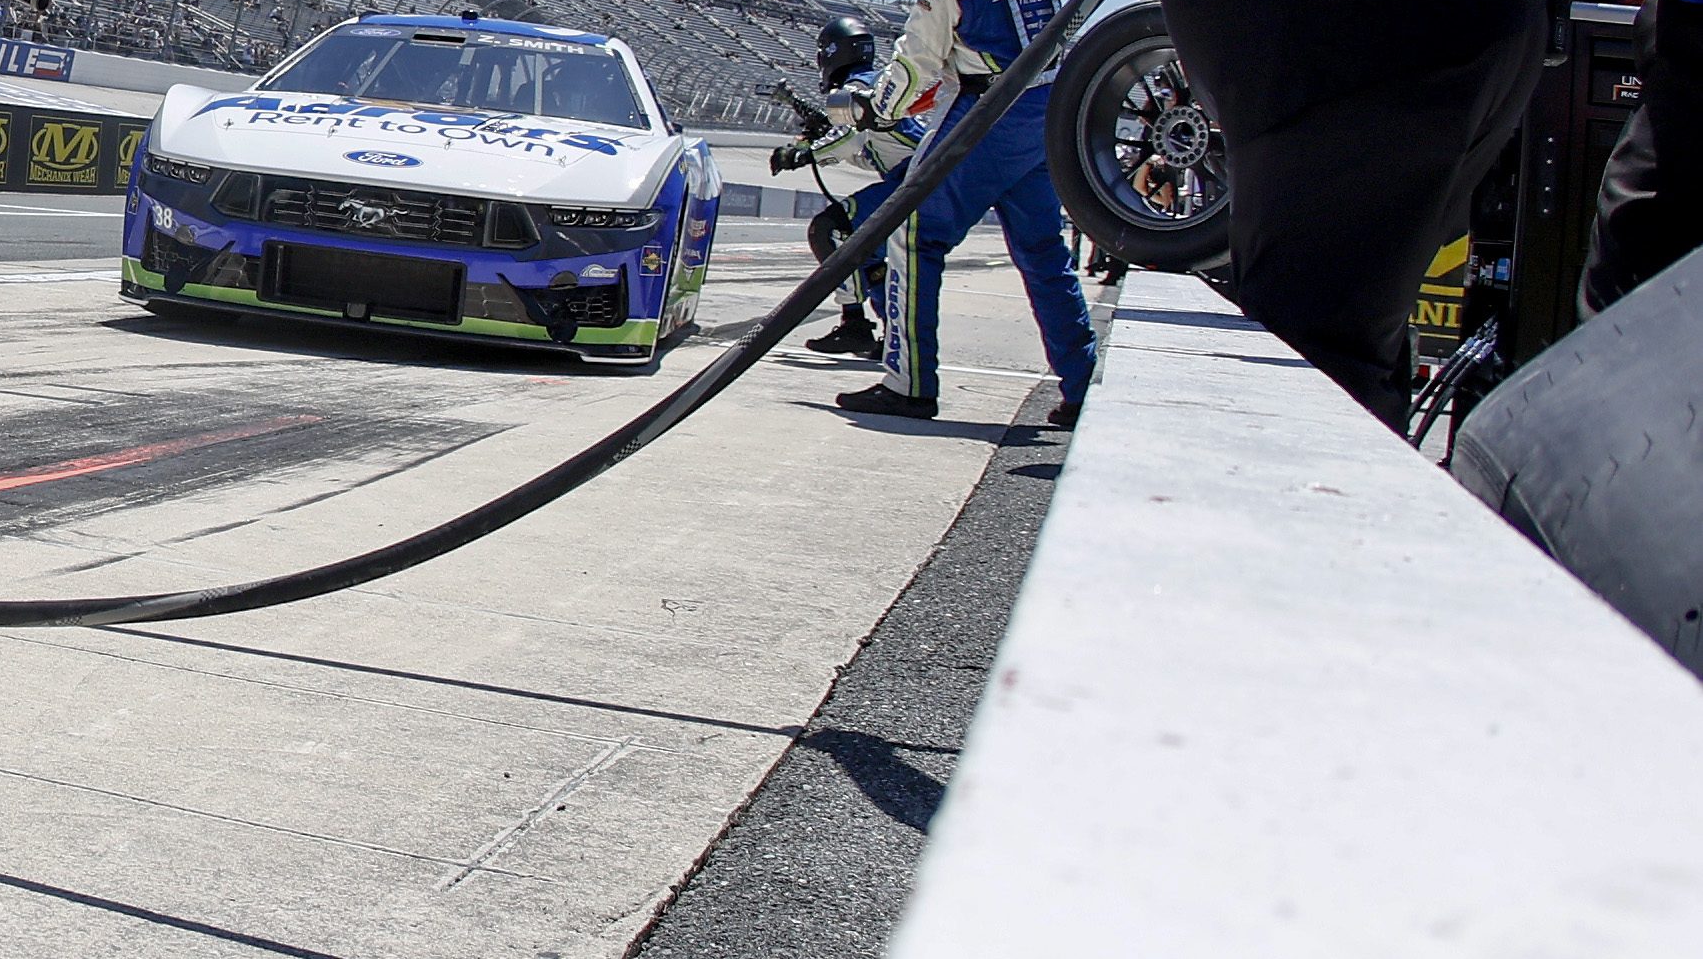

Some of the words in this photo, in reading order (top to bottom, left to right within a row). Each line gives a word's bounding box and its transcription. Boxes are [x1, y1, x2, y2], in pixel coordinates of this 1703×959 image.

[477, 34, 502, 45] Z.
[508, 38, 585, 55] SMITH
[247, 111, 370, 129] Rent
[379, 119, 428, 135] to
[437, 127, 555, 158] Own
[358, 151, 408, 167] Ford
[29, 161, 72, 182] MECHANIX
[73, 167, 96, 184] WEAR
[155, 205, 173, 229] 38
